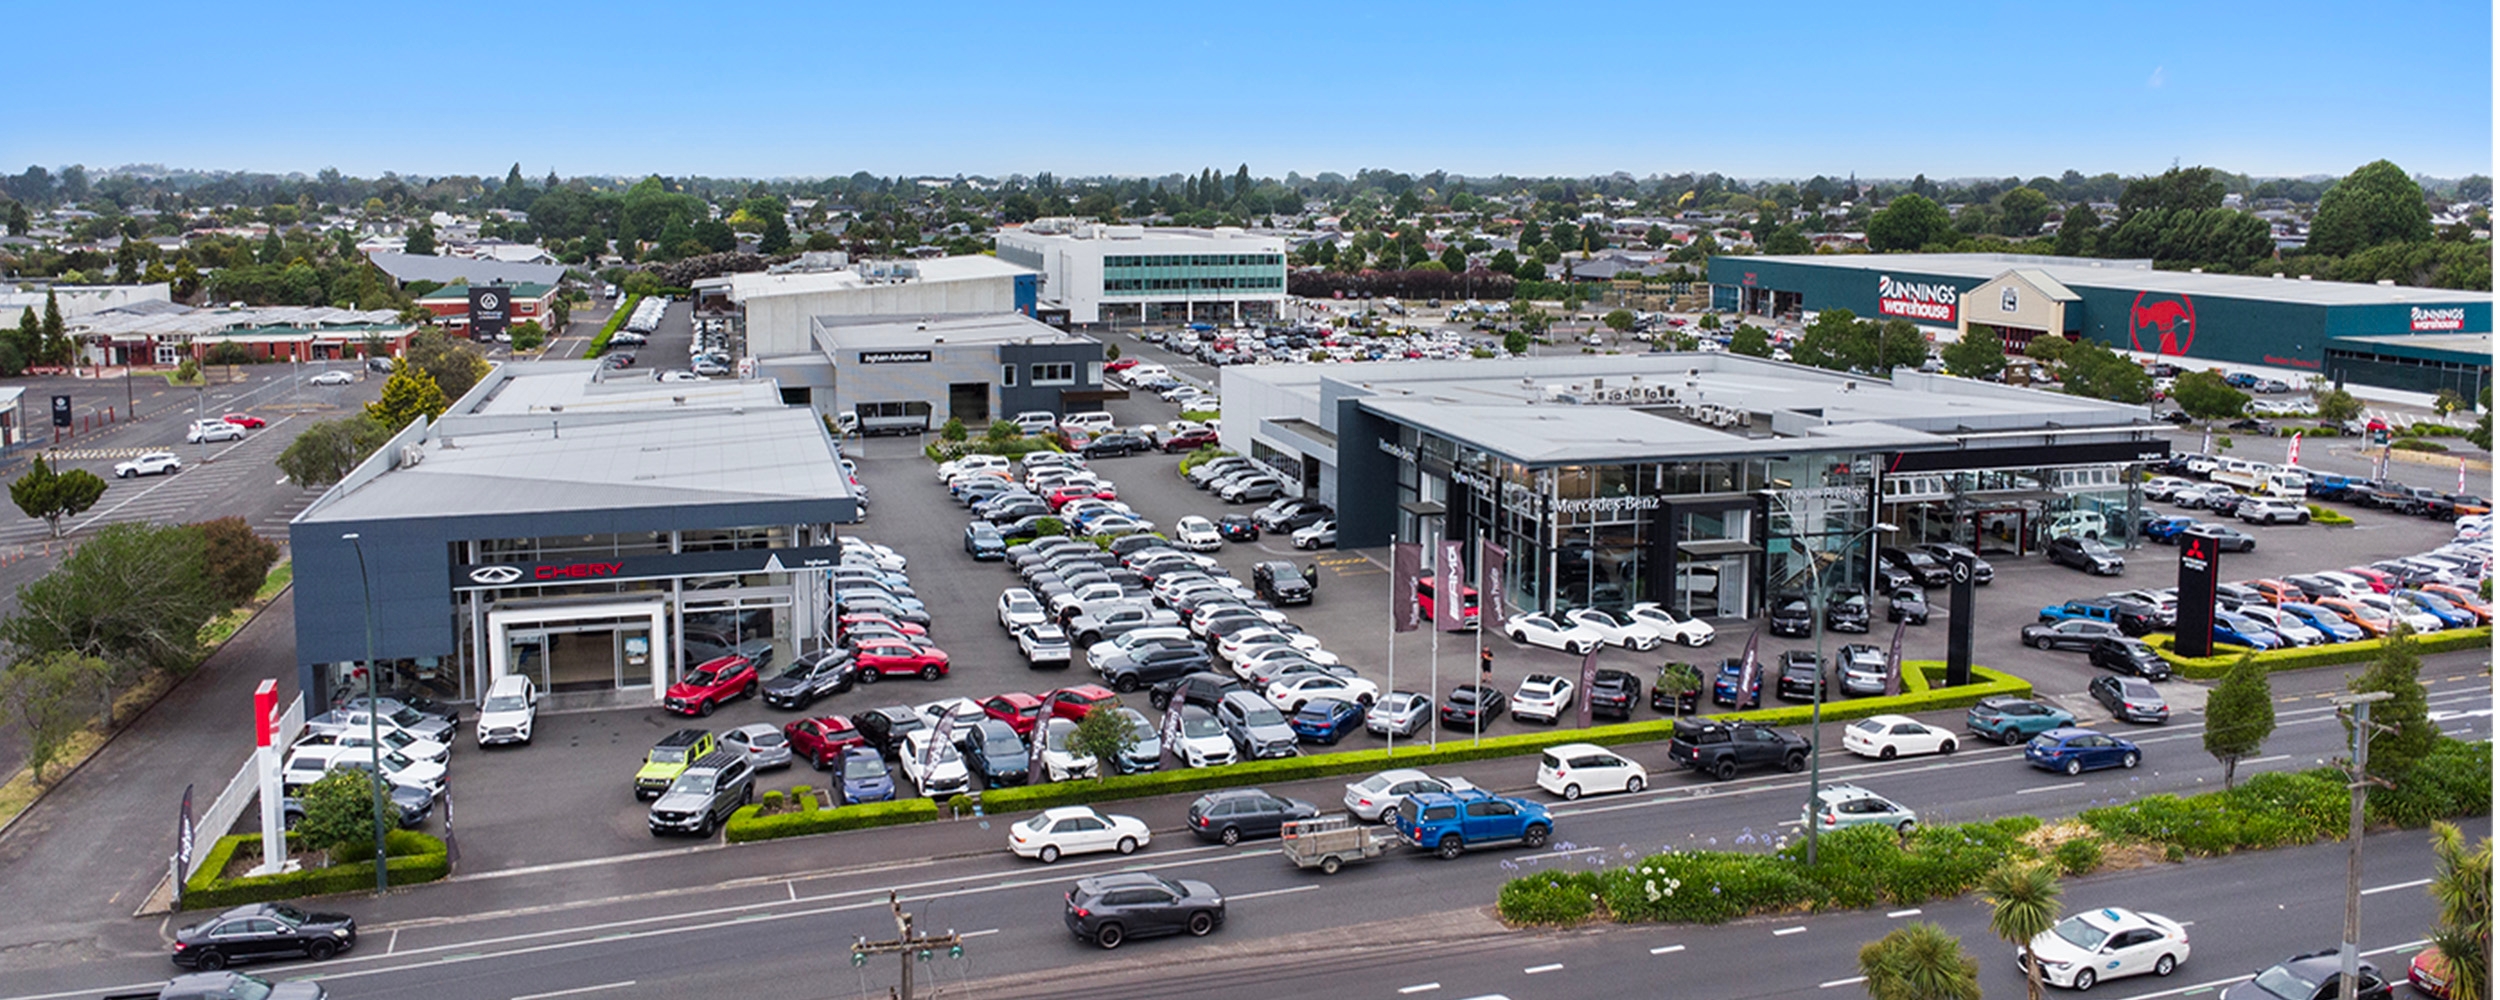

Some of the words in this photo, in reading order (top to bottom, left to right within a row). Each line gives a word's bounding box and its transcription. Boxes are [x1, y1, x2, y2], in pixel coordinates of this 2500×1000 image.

[1879, 275, 1956, 304] BUNNINGS
[1883, 298, 1950, 319] warehouse
[2411, 306, 2464, 320] BUNNINGS
[1554, 496, 1660, 513] Mercedes-Benz
[535, 562, 623, 579] CHERY
